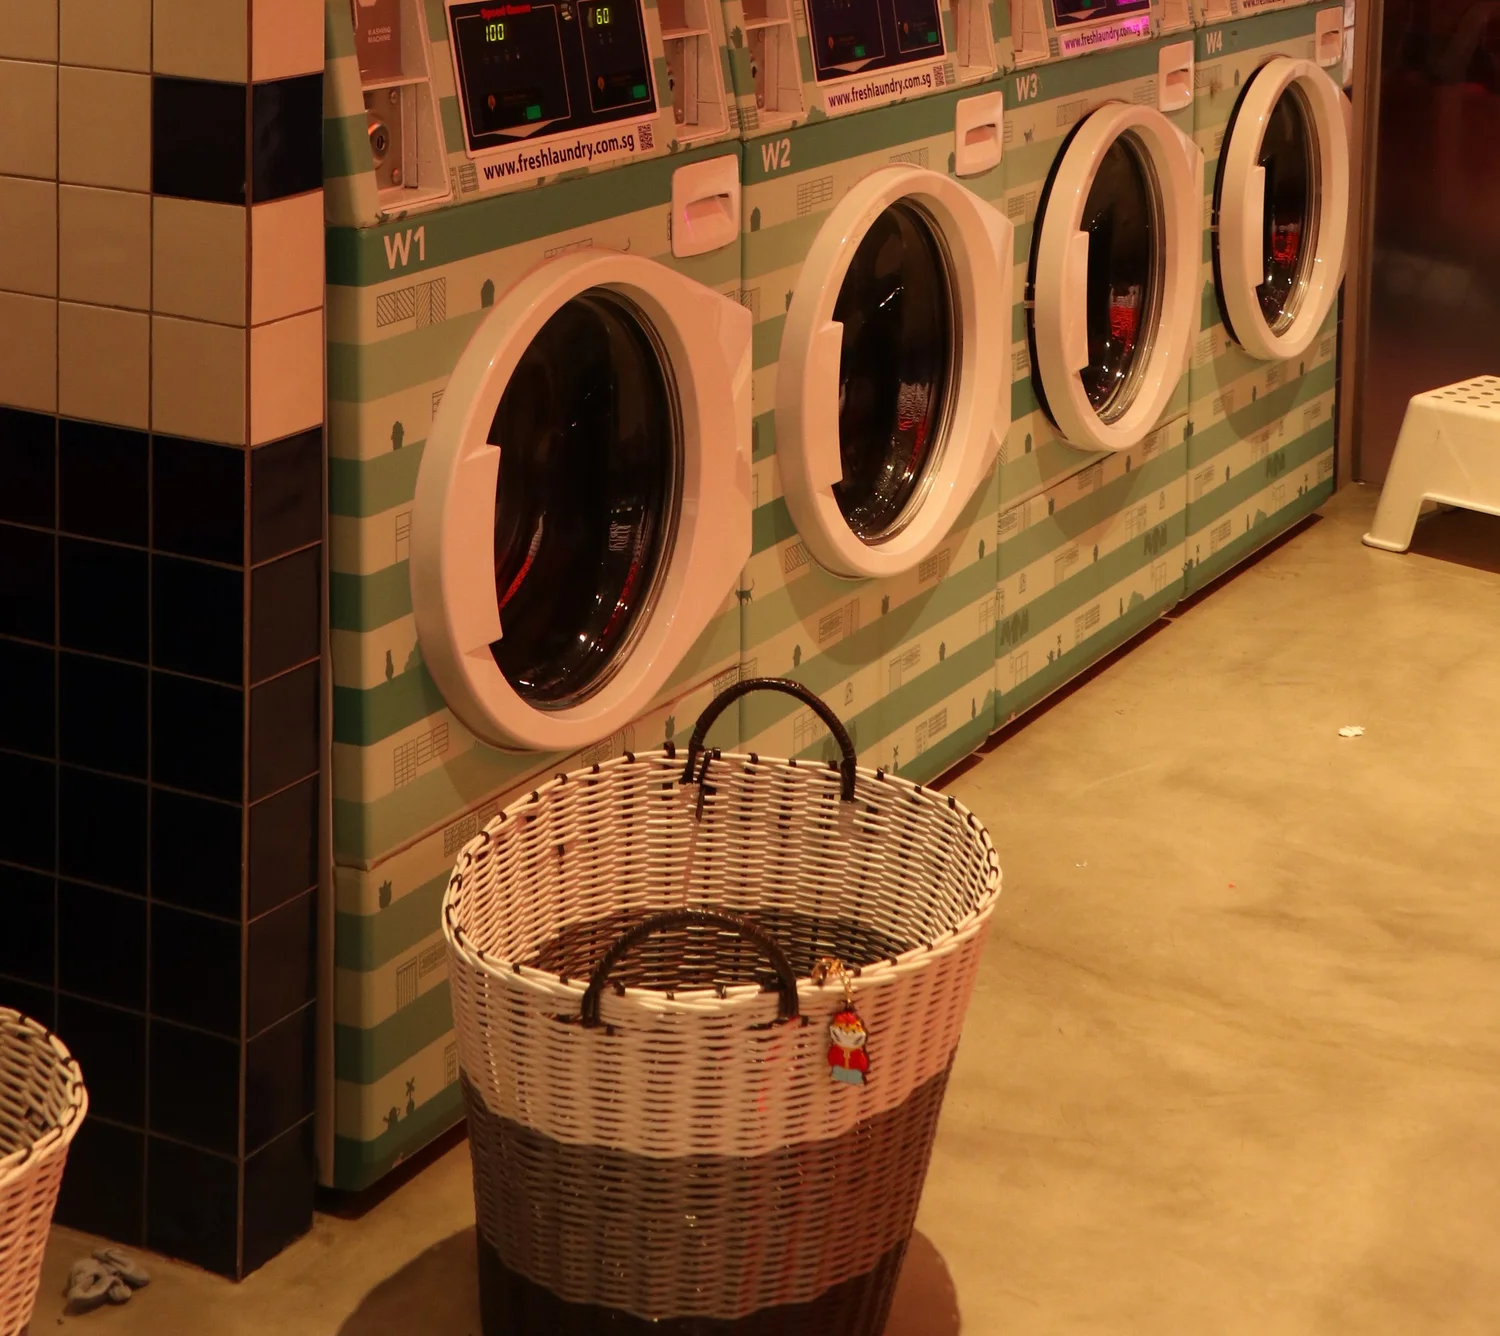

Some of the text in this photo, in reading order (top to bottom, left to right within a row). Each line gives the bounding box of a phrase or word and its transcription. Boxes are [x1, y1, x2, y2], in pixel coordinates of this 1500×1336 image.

[596, 7, 610, 25] 60
[367, 26, 392, 36] WASHING
[367, 34, 392, 43] MACHINE
[485, 23, 505, 42] 100
[1064, 23, 1141, 50] www.freshlaundry.com.sg
[1206, 30, 1223, 54] W4
[828, 72, 932, 108] www.freshlaundry.com.sg
[1015, 72, 1039, 102] W3
[483, 133, 635, 180] www.freshlaundry.com.sg
[761, 137, 792, 173] W2
[383, 225, 426, 270] W1
